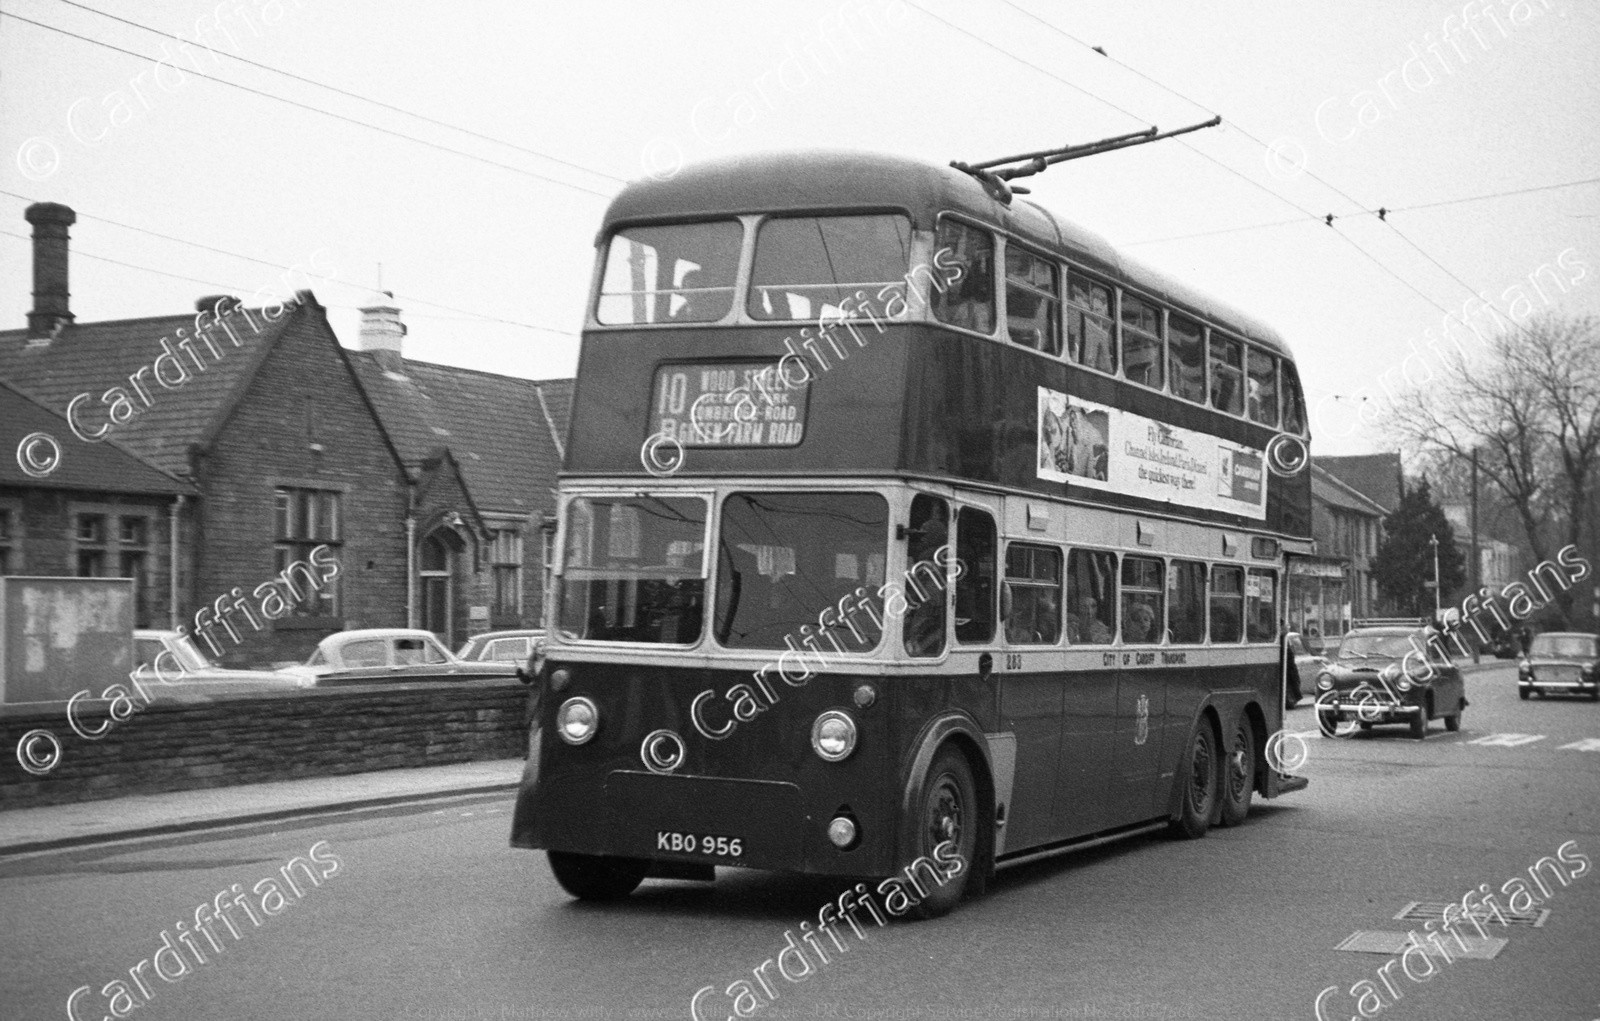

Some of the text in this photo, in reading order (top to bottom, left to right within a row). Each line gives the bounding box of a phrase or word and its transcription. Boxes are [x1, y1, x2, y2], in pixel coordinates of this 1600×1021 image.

[659, 373, 687, 414] 10
[765, 405, 797, 420] ROAD
[768, 422, 802, 443] ROAD
[657, 832, 742, 856] KBO 956
